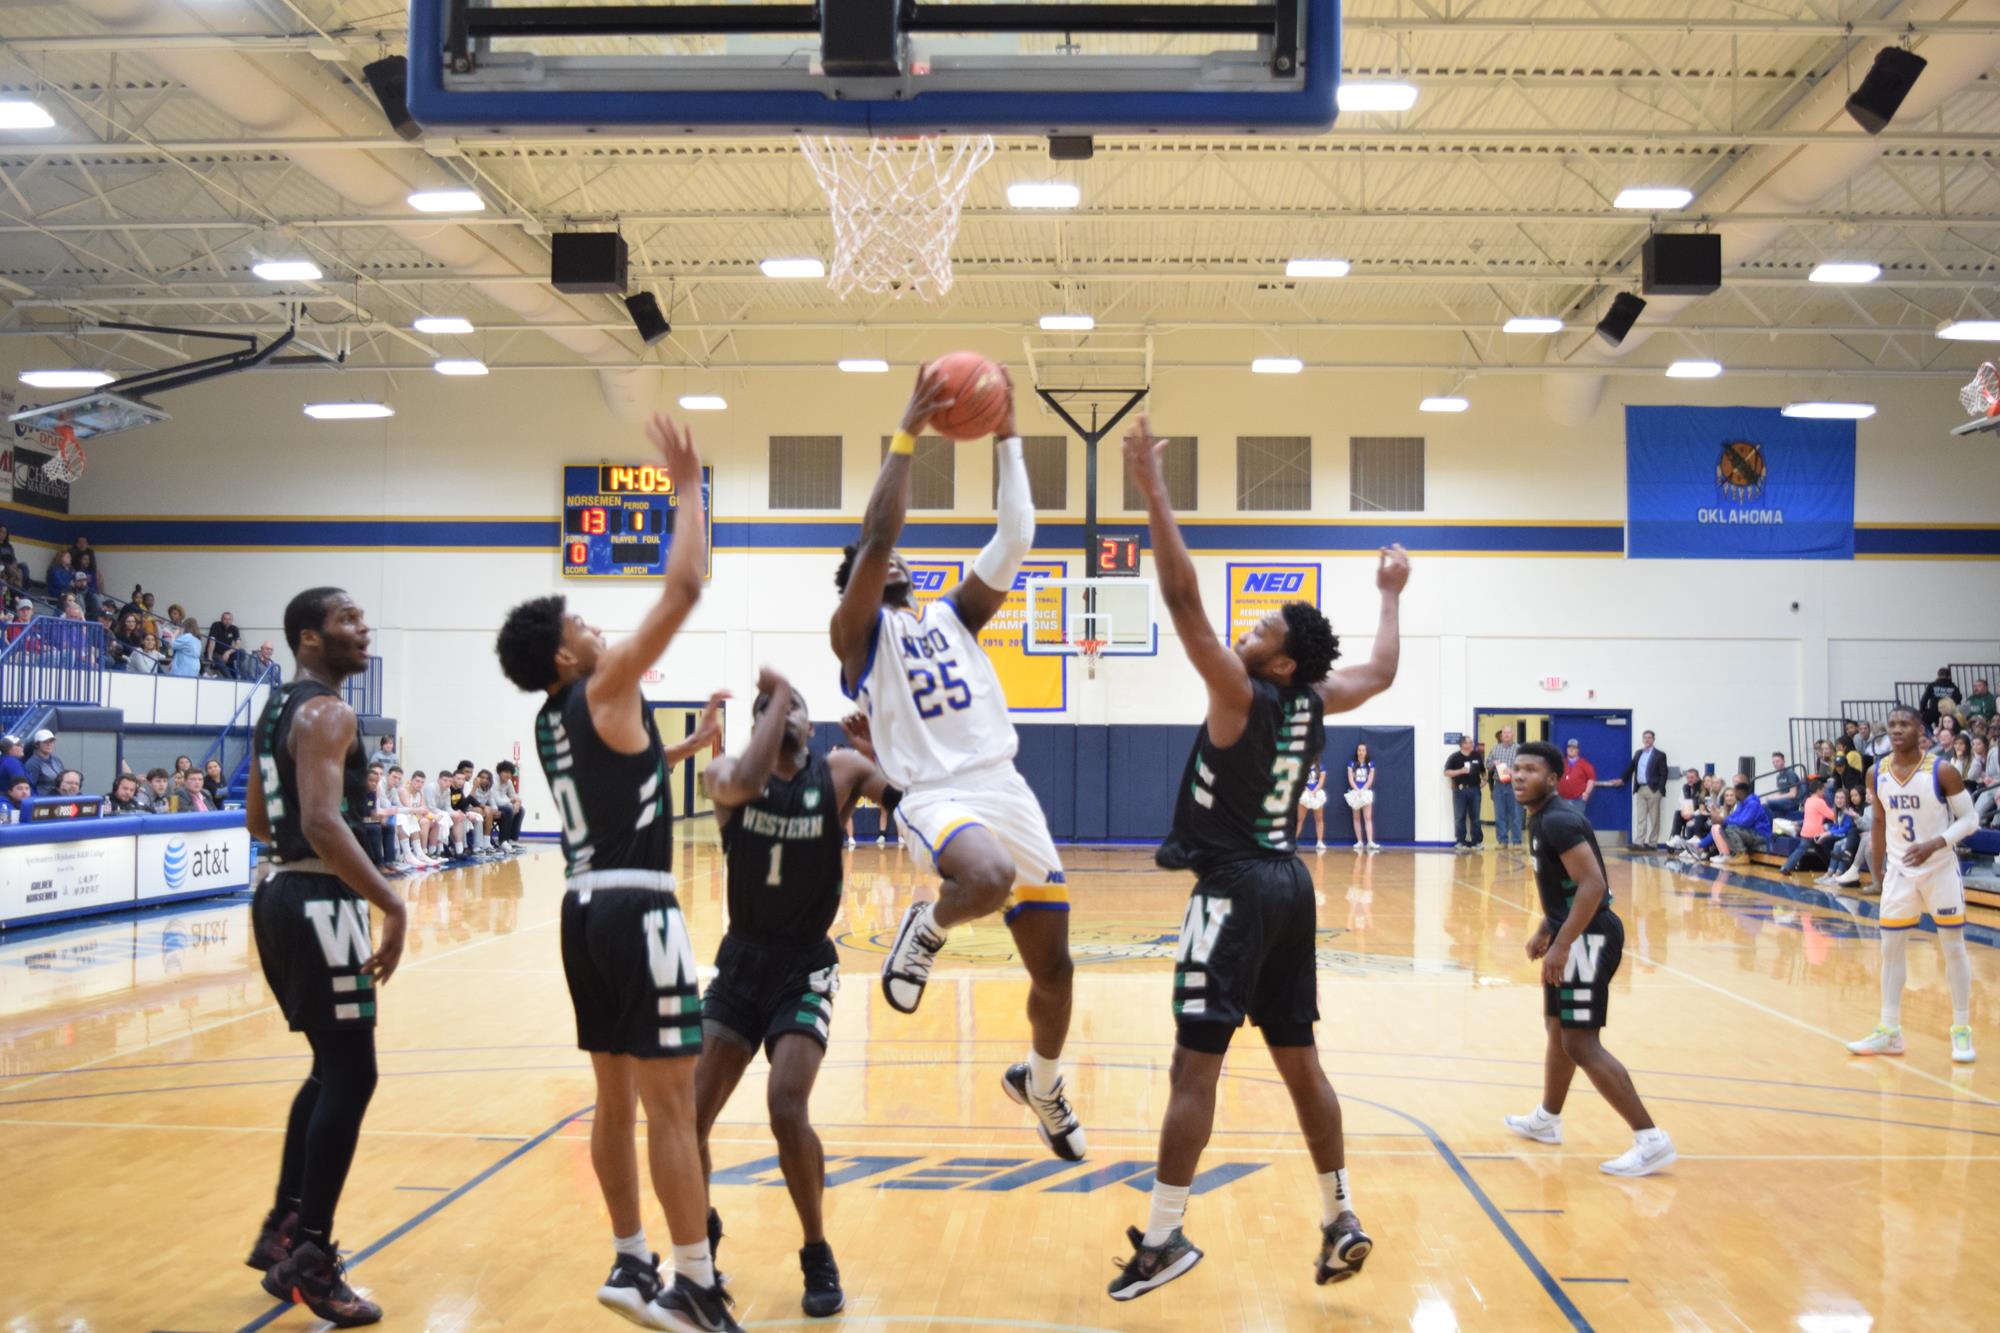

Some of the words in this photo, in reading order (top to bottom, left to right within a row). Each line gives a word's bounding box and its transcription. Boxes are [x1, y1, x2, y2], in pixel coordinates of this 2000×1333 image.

[610, 467, 671, 492] 14:05
[567, 496, 622, 506] NORSEMEN
[624, 502, 649, 510] PERIOD
[582, 508, 606, 534] 13
[634, 512, 643, 531] 1
[1698, 508, 1783, 524] OKLAHOMA
[571, 543, 587, 563] 0
[611, 535, 637, 544] PLAYER
[642, 535, 660, 544] FOUL
[1101, 541, 1135, 569] 21
[624, 566, 648, 574] MATCH
[912, 571, 948, 591] EO
[1242, 572, 1305, 593] NEO
[901, 628, 950, 659] NEO
[909, 659, 972, 719] 25
[1264, 754, 1302, 815] 3
[553, 774, 588, 846] 0
[1889, 795, 1920, 809] NEO
[742, 805, 823, 839] WESTERN
[1898, 814, 1916, 842] 3
[192, 842, 230, 877] at&t
[766, 842, 783, 886] 1
[305, 899, 374, 968] W
[1176, 895, 1232, 964] W
[643, 907, 697, 989] W
[710, 1154, 1271, 1196] NEO
